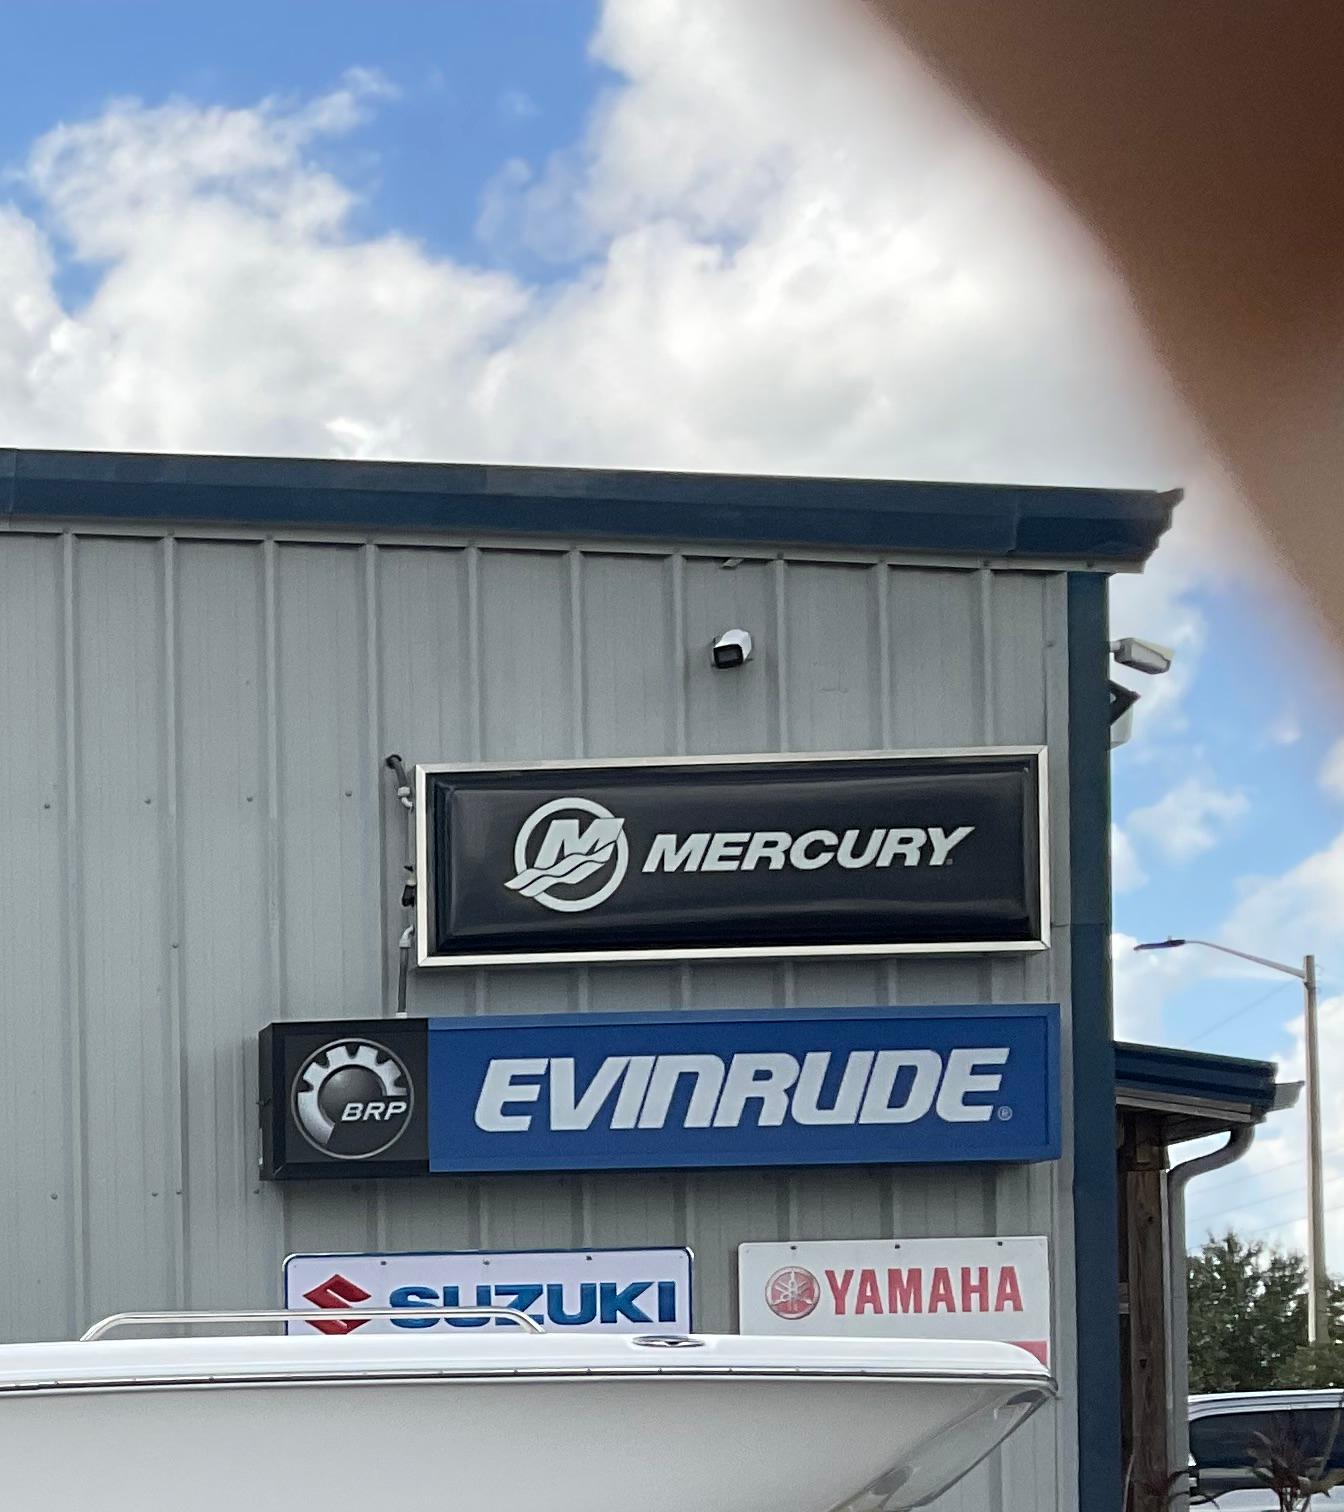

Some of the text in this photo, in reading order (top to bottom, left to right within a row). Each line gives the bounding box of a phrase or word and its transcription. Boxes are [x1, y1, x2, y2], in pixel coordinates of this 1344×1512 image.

[641, 826, 976, 873] MERCURY
[341, 1100, 408, 1123] BRP
[473, 1047, 1011, 1133] EVINRUDE
[389, 1281, 676, 1328] SUZUKI
[824, 1266, 1024, 1316] YAMAHA
